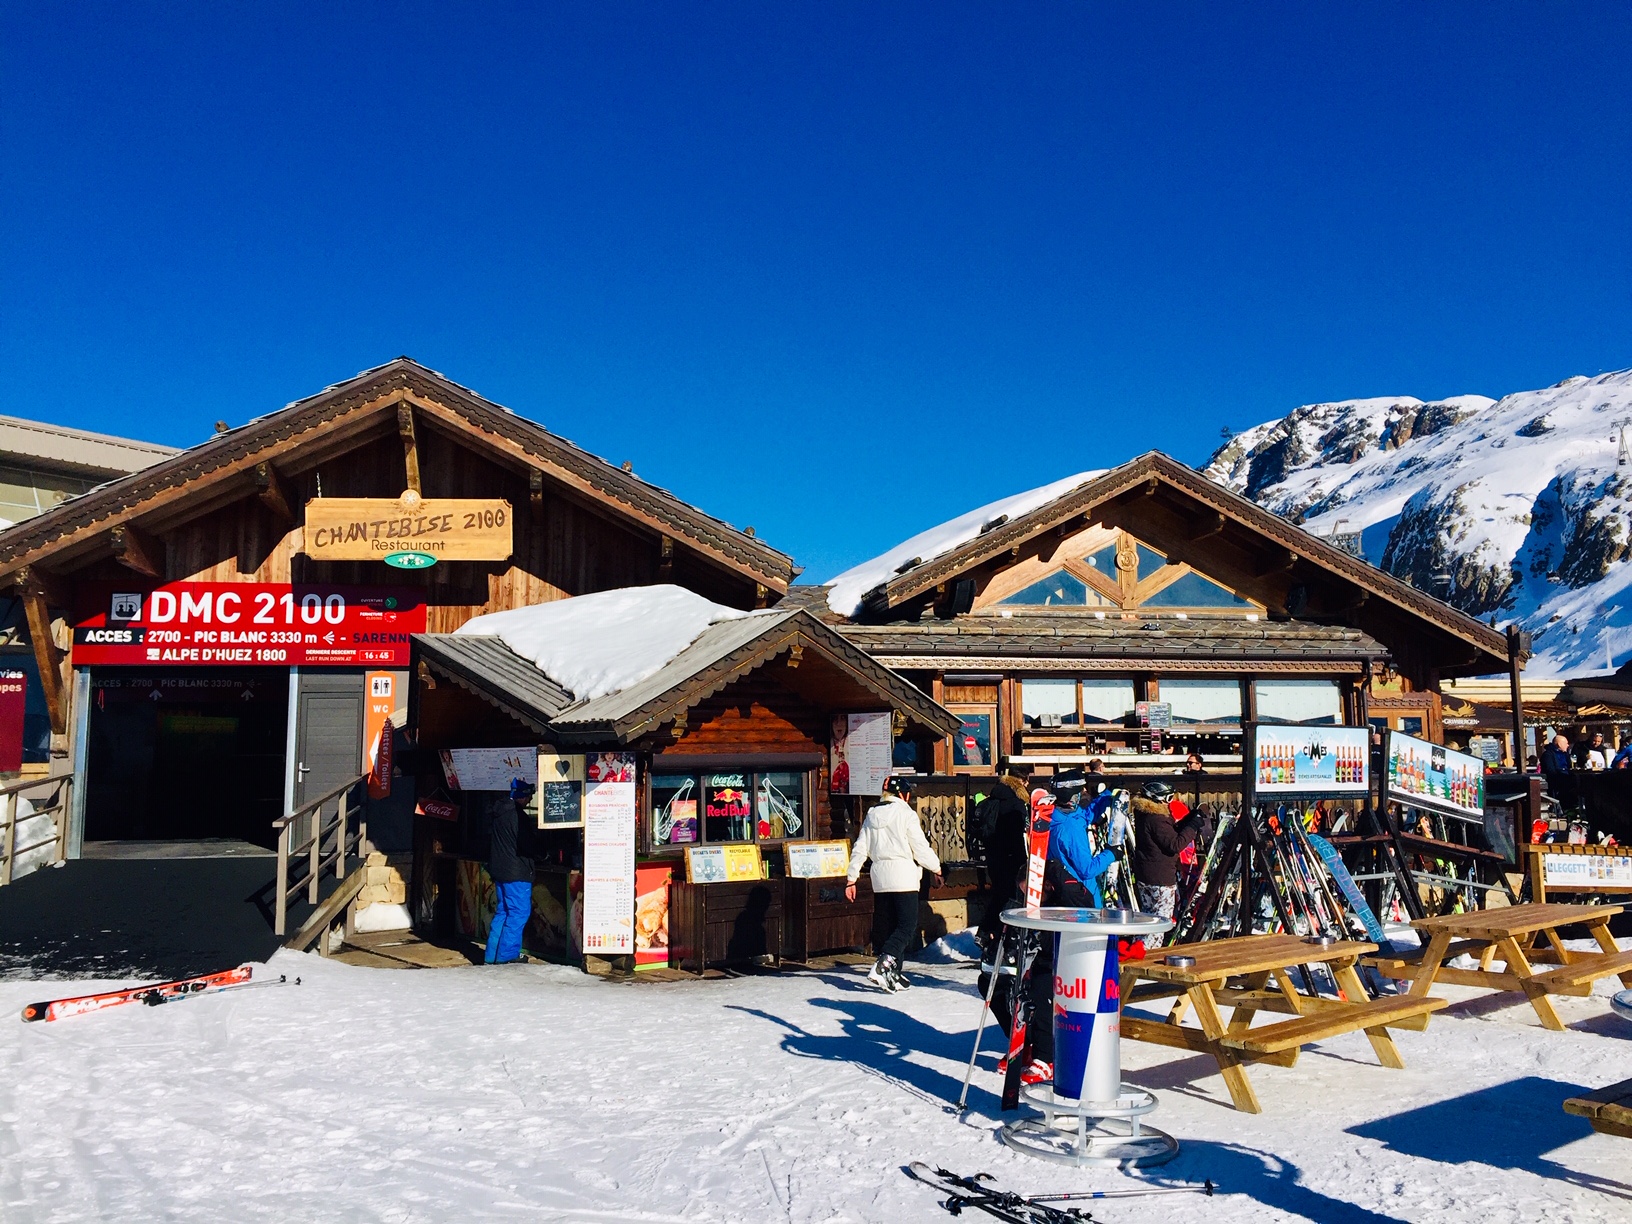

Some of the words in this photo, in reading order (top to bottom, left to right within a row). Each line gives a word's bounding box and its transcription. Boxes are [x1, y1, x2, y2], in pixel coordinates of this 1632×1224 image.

[314, 514, 453, 547] CHANTEBISE
[463, 508, 506, 530] 2100
[371, 539, 446, 551] Restaurant
[150, 591, 242, 623] DMC
[253, 592, 346, 624] 2100
[85, 630, 132, 643] ACCES
[148, 631, 181, 643] 2700
[194, 631, 218, 643] PIC
[220, 631, 267, 643] BLANC
[270, 631, 302, 644] 3330
[305, 634, 317, 643] m
[162, 649, 199, 660] ALPE
[202, 649, 252, 661] D'HUEZ
[256, 649, 287, 661] 1800
[364, 652, 374, 660] 16
[379, 652, 389, 660] 45
[131, 679, 153, 688] 2700
[161, 679, 177, 688] PIC
[178, 679, 209, 688] BLANC
[210, 679, 232, 688] 3330
[373, 705, 389, 713] WC
[1303, 741, 1327, 760] CIMES
[381, 762, 390, 790] Toilets
[707, 804, 728, 817] Red
[730, 802, 750, 816] Bull
[1554, 862, 1586, 874] LEGGETT
[1053, 975, 1086, 1000] Bull
